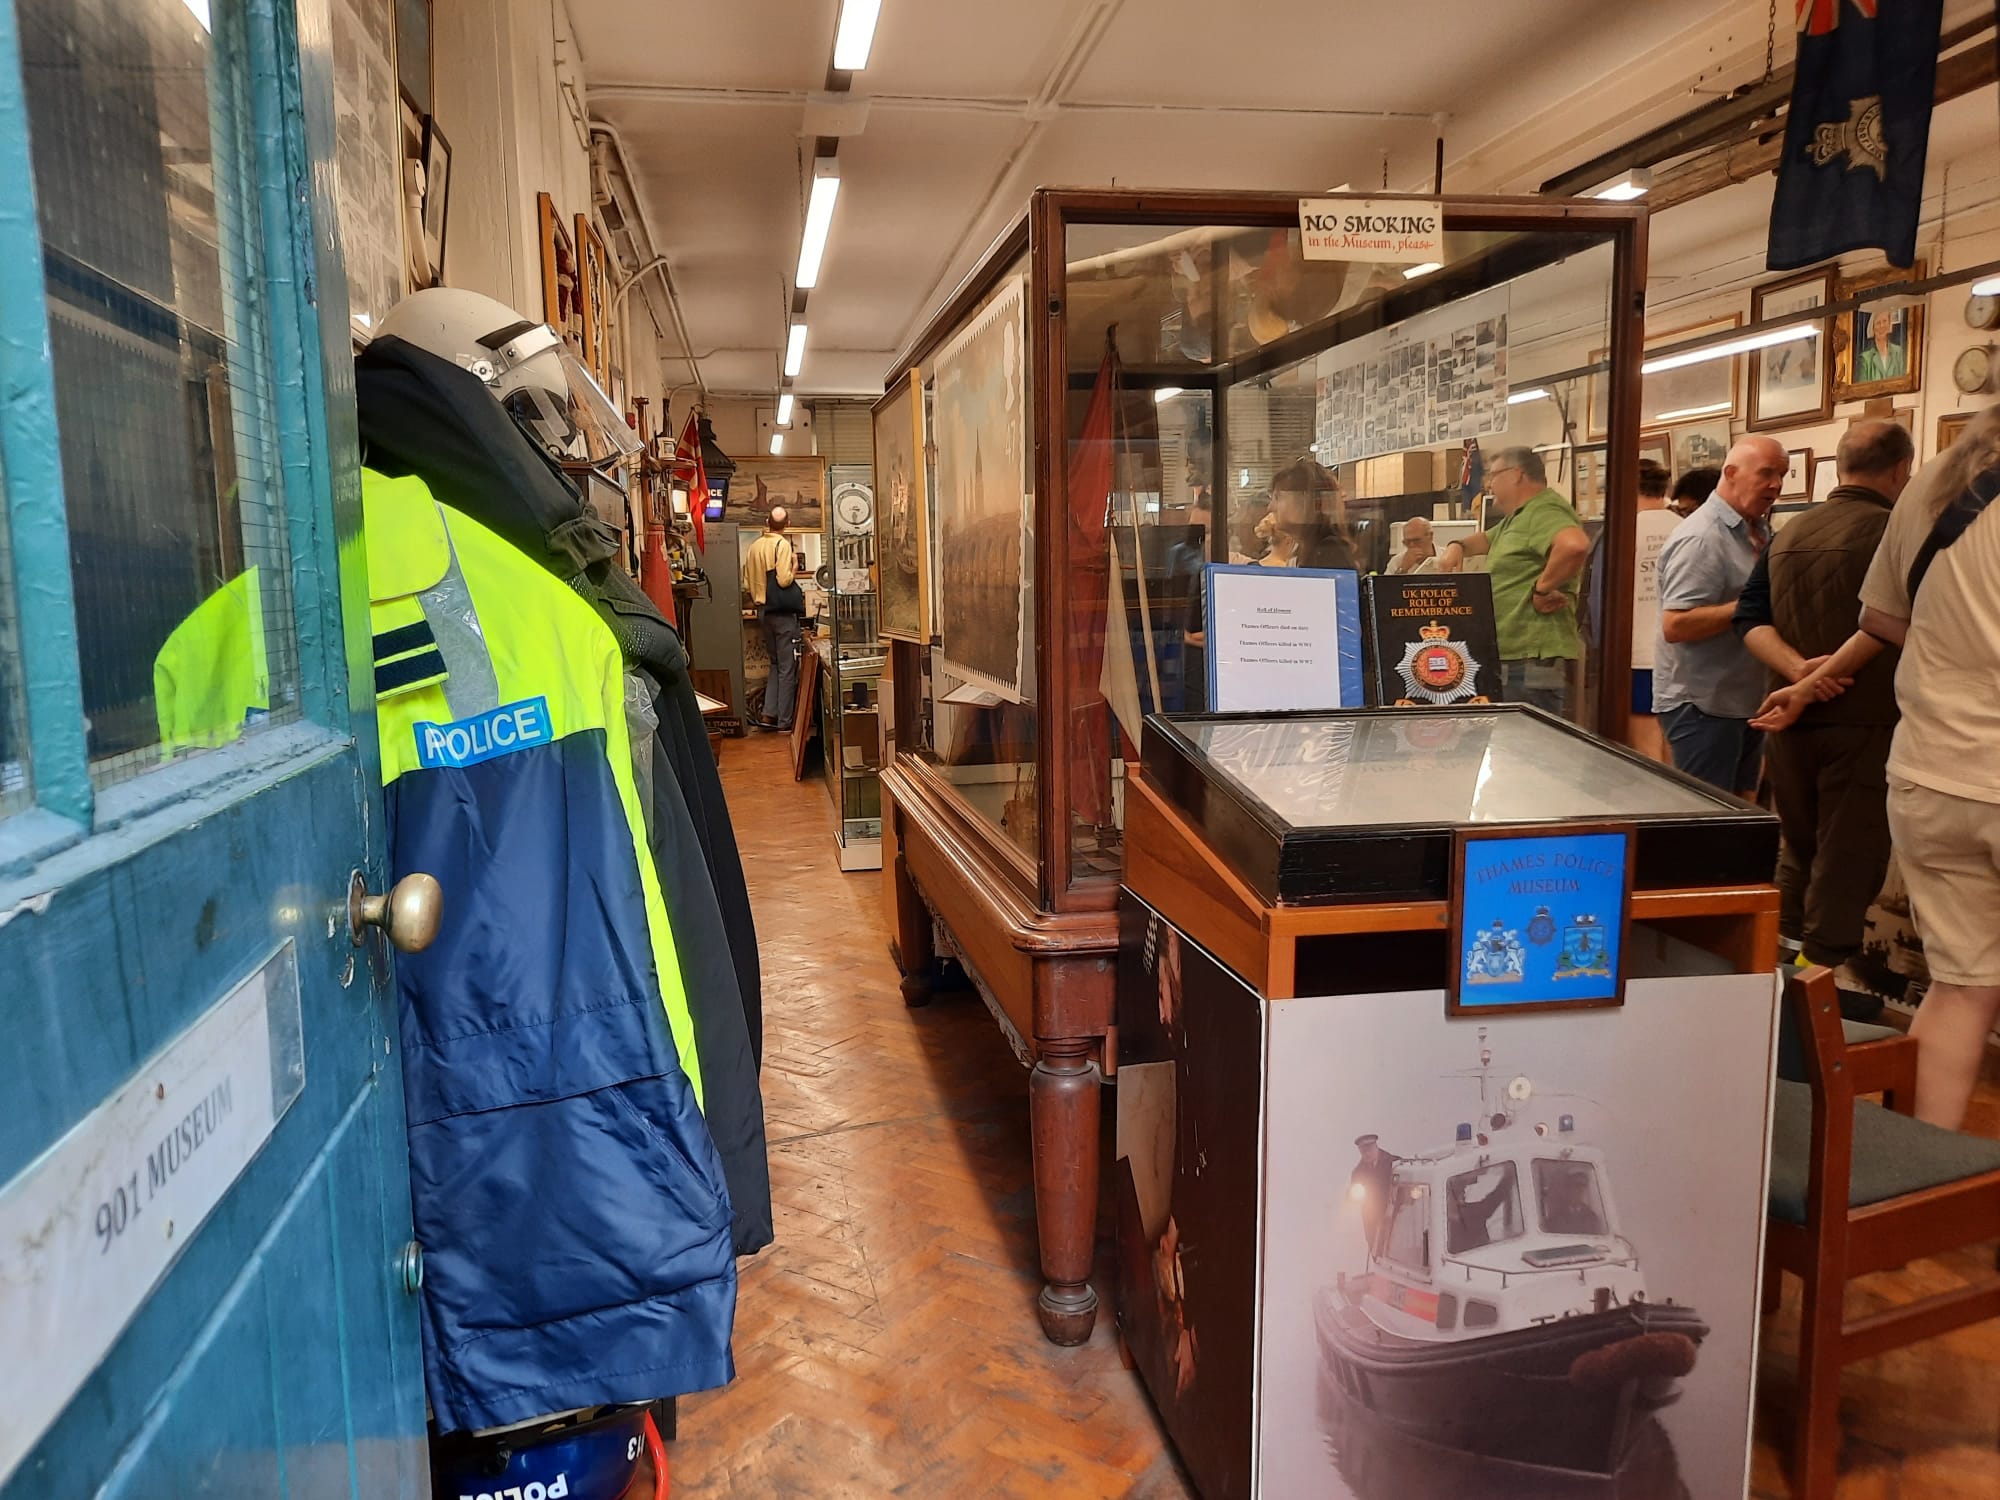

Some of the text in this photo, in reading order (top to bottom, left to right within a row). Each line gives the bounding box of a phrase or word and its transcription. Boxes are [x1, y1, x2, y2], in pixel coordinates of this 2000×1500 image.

[1304, 215, 1435, 233] NO SMOKING
[1308, 236, 1320, 247] in
[1324, 234, 1339, 247] the
[1341, 233, 1396, 250] Museum,
[1402, 589, 1457, 599] UK POLICE
[1409, 598, 1453, 607] ROLL OF
[1391, 606, 1473, 617] REMEMBRANCE
[424, 706, 541, 760] POLICE
[1476, 852, 1616, 883] THAMES POLICE
[1510, 878, 1580, 894] MUSEUM
[94, 1075, 234, 1255] 901 MUSEUM
